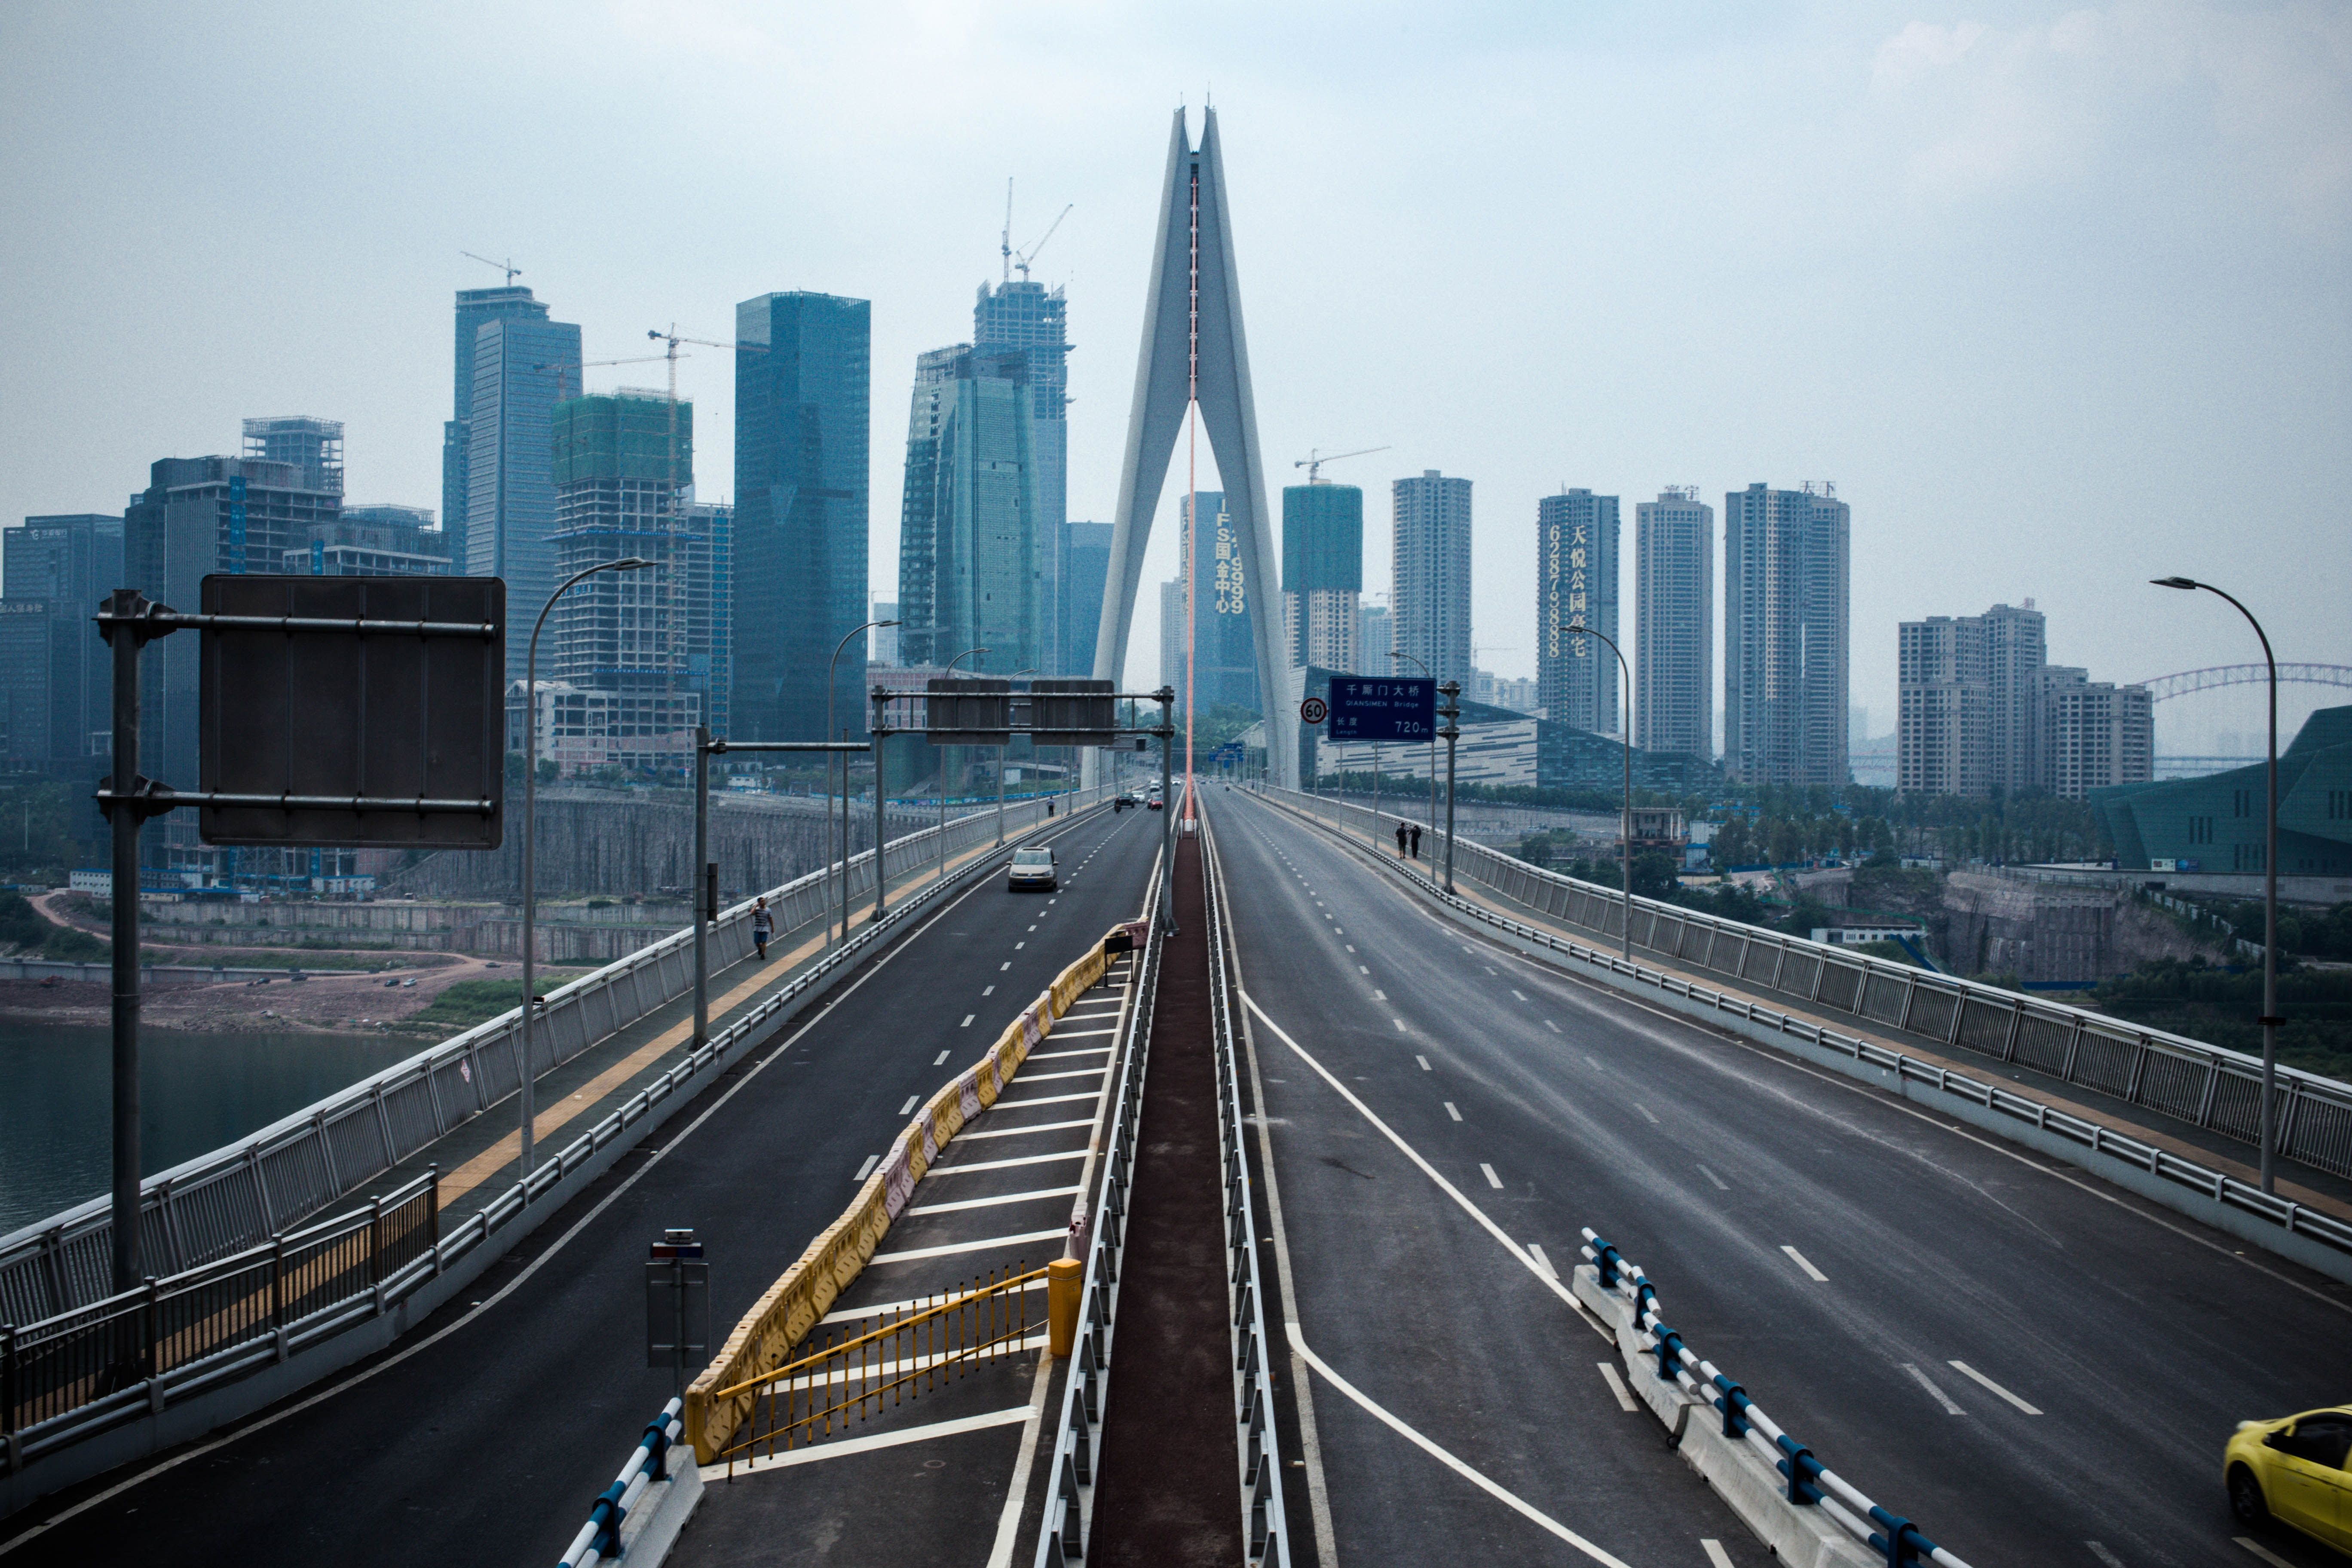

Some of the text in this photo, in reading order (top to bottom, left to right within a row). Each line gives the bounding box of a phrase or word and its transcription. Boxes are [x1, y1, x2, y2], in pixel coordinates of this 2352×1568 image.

[1800, 481, 1834, 497] 天下
[1347, 684, 1419, 696] 千厮门大桥
[1305, 704, 1322, 718] 60
[1336, 717, 1358, 726] 长度
